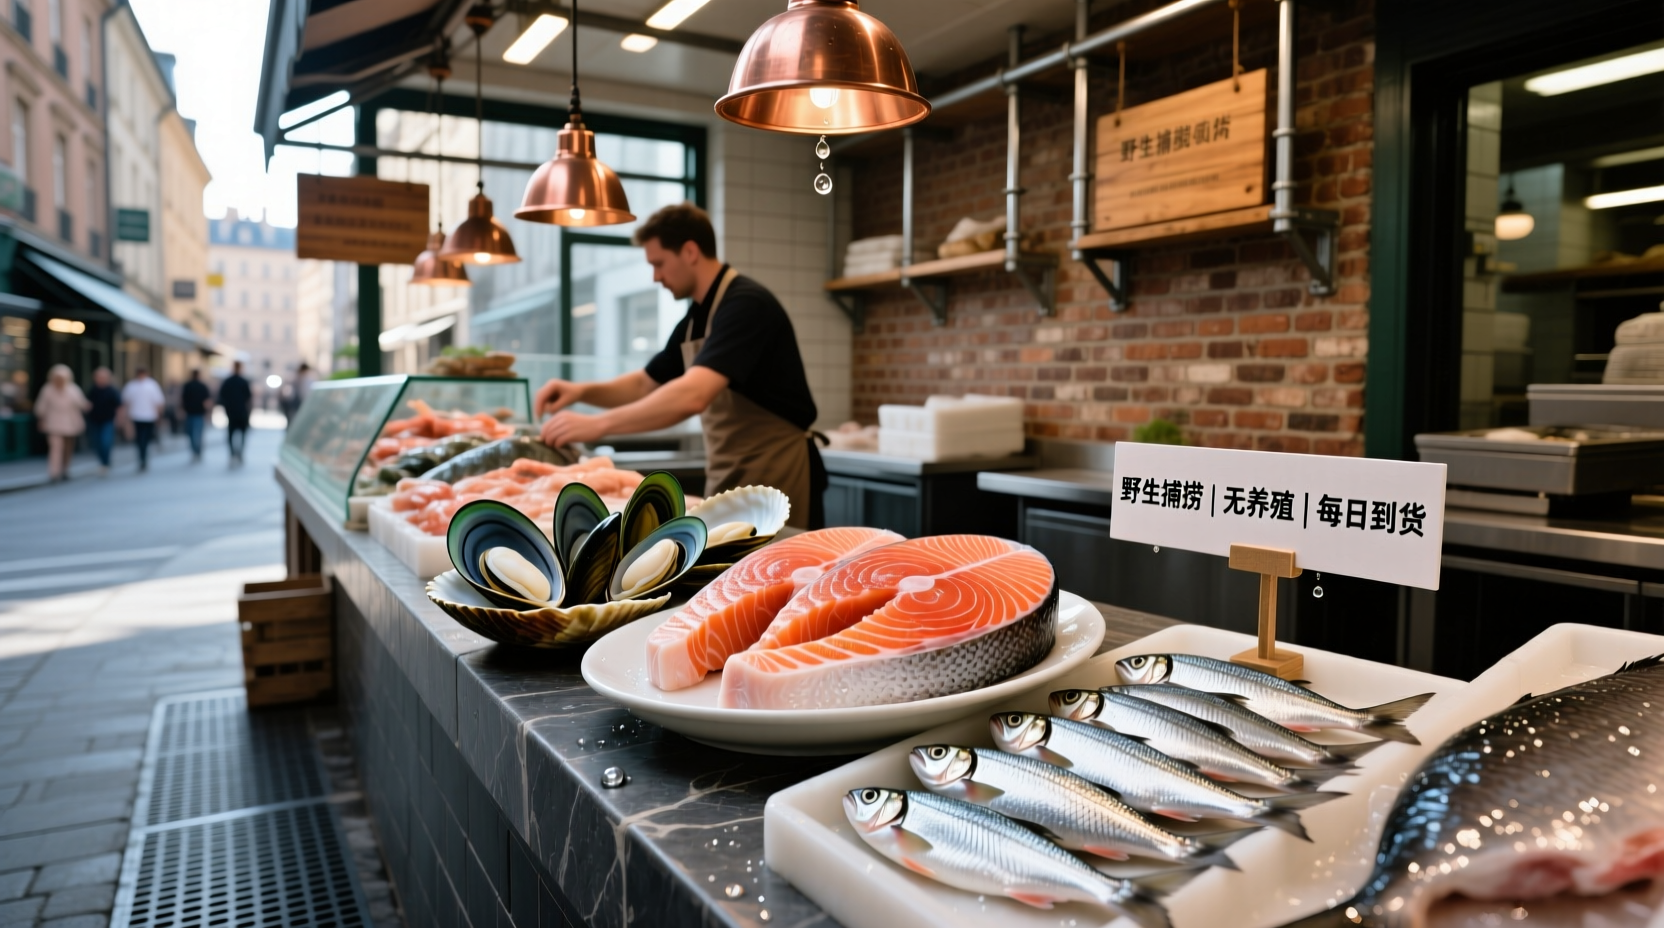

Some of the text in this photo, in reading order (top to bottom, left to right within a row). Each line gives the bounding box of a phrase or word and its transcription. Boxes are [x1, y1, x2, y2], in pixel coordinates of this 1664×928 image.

[1121, 477, 1205, 510] 野生捕捞
[1223, 487, 1294, 521] 无养殖
[1317, 494, 1427, 537] 每日到货
